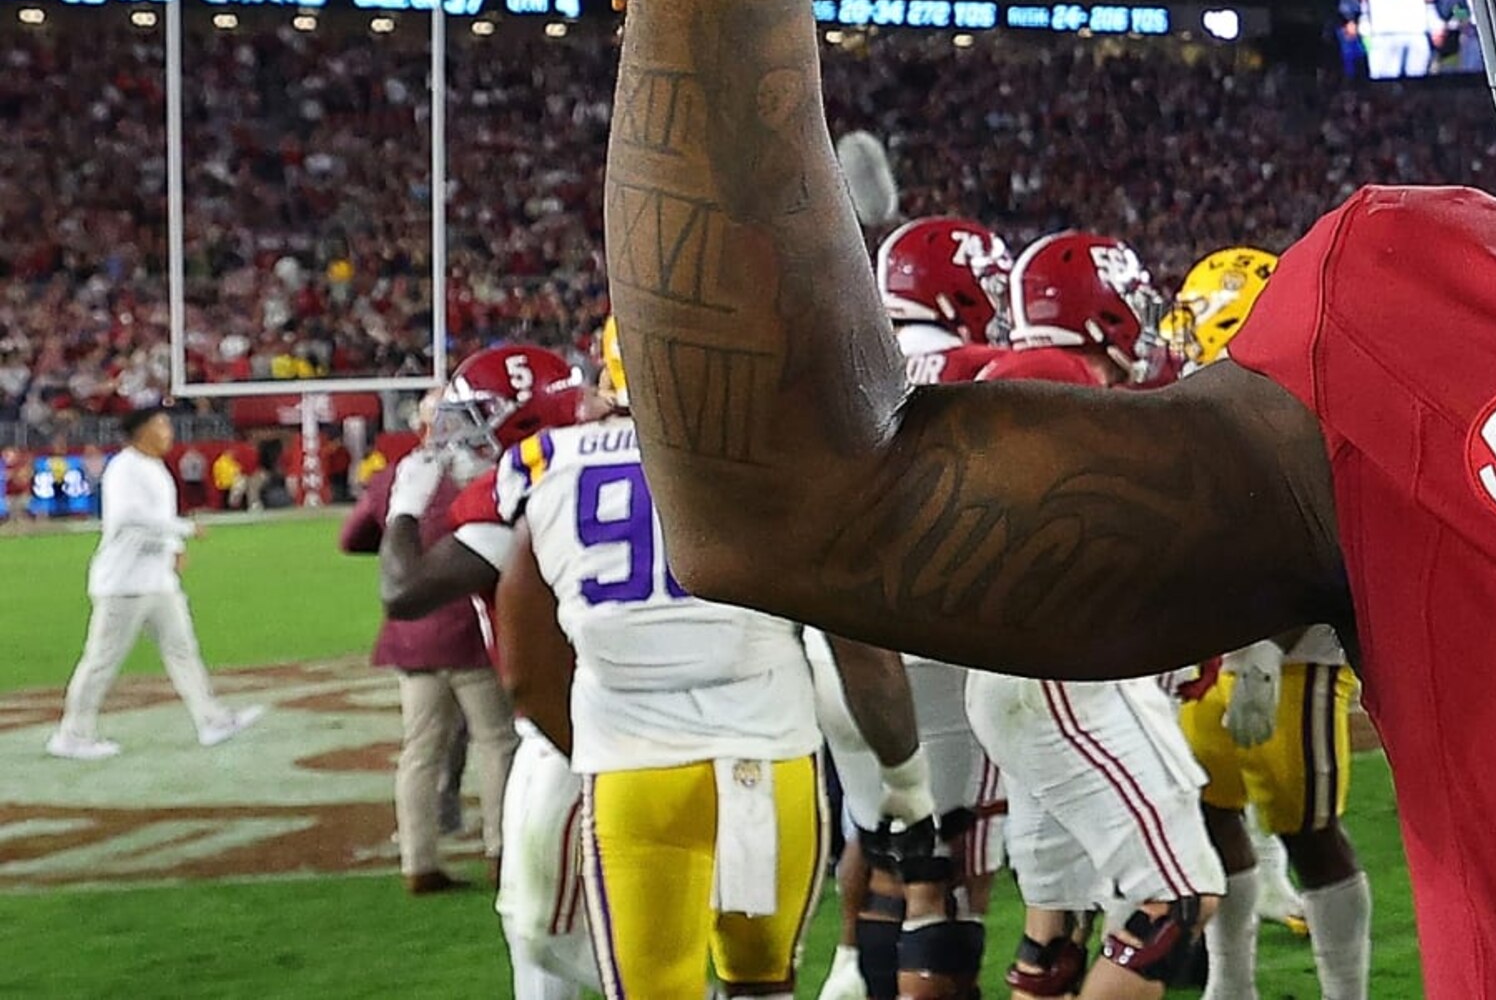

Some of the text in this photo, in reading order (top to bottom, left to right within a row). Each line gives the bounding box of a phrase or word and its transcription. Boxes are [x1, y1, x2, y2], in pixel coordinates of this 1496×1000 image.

[505, 354, 533, 391] 5
[578, 430, 639, 455] GUI
[576, 462, 692, 604] 9
